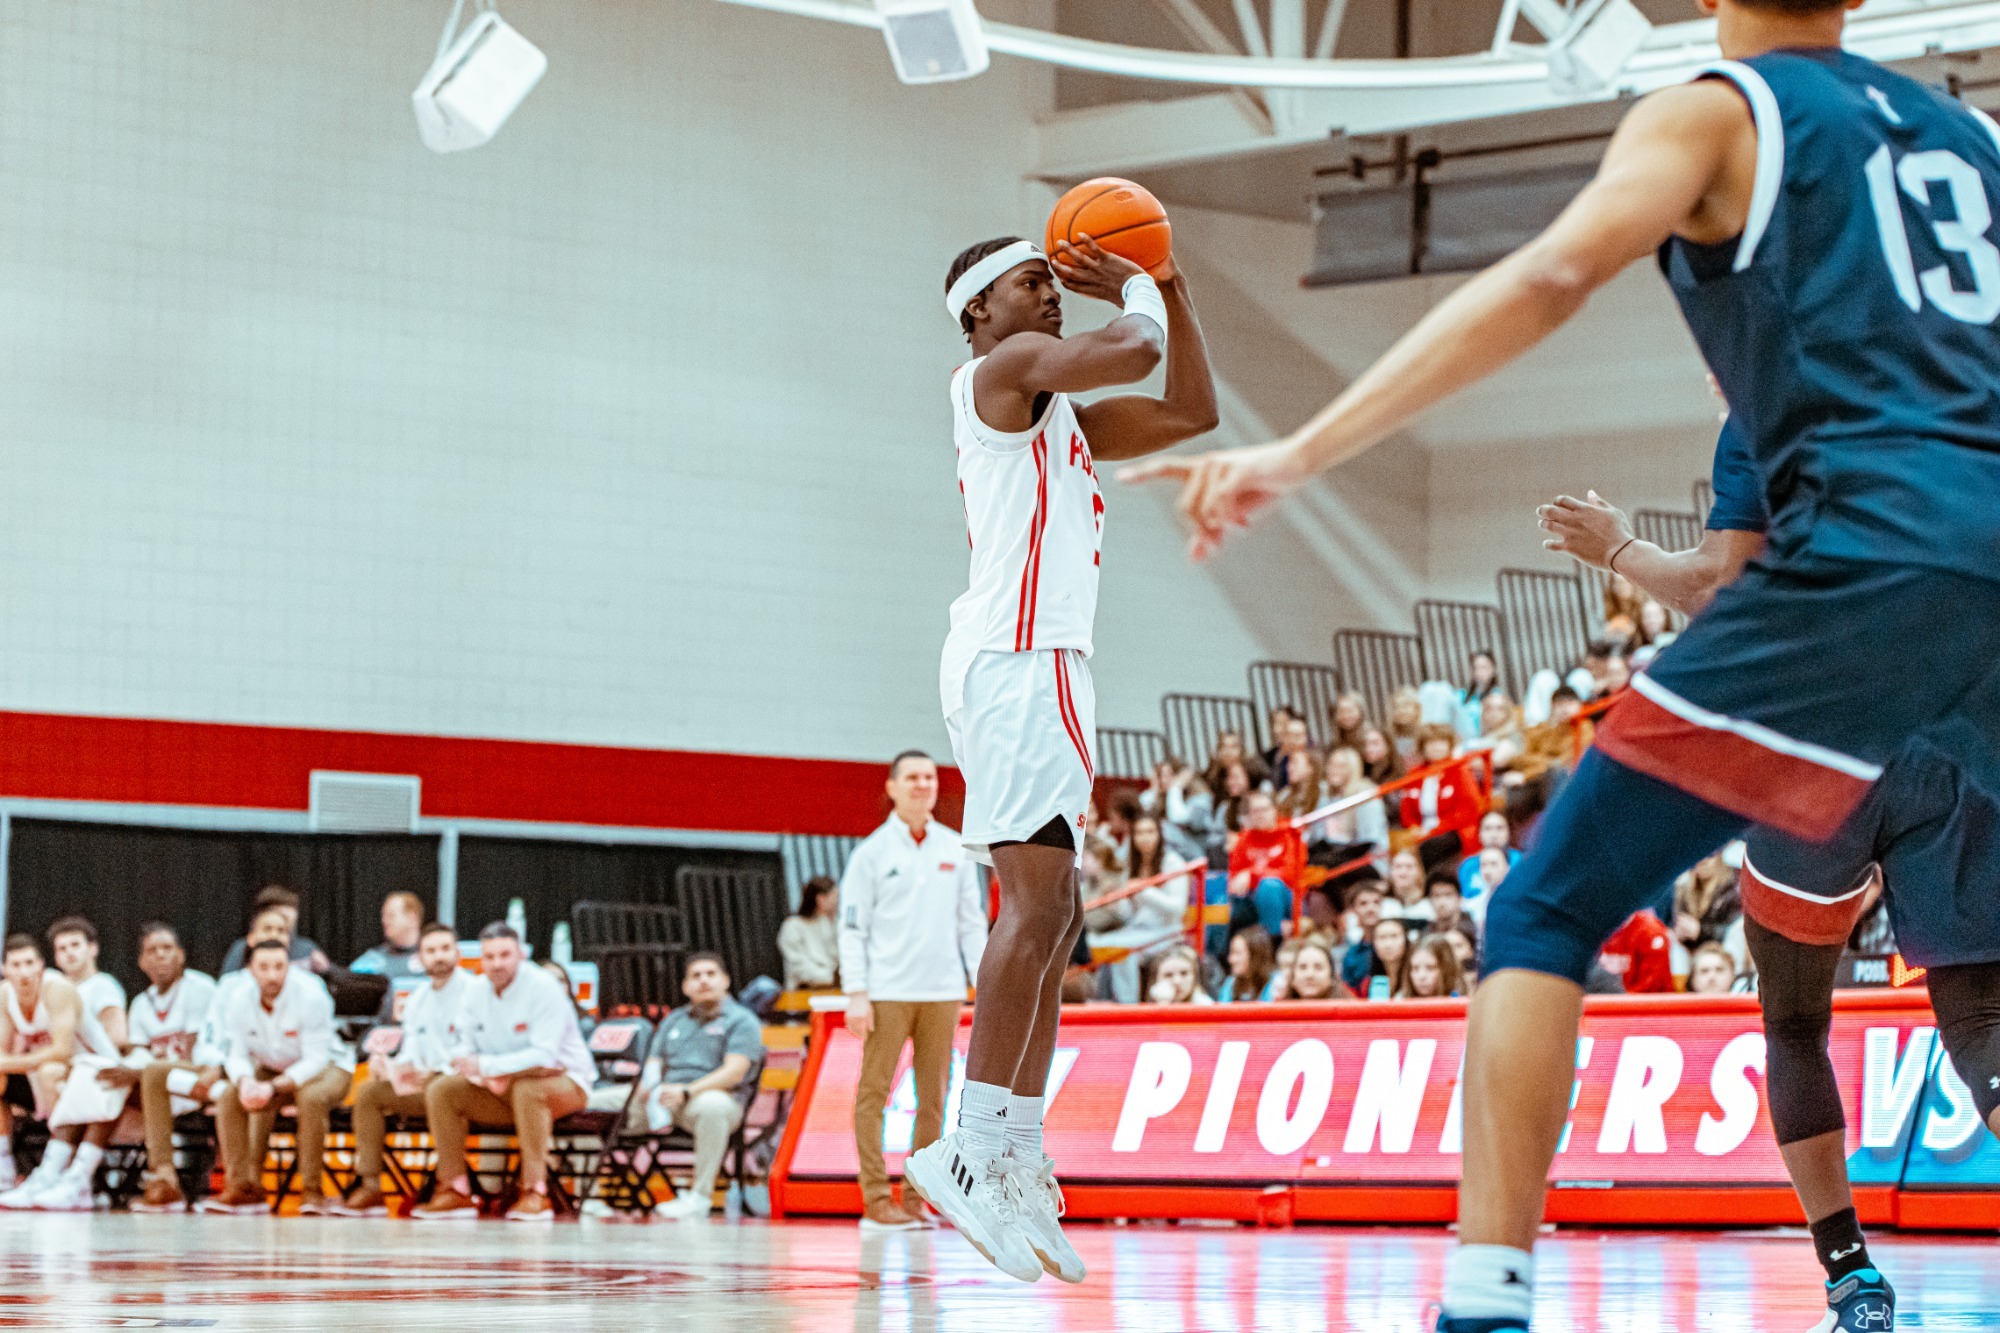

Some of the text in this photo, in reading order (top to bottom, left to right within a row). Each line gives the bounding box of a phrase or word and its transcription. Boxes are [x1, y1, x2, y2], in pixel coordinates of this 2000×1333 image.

[1864, 144, 2000, 324] 13
[1111, 1032, 1767, 1156] PIONRS
[1861, 1026, 1982, 1151] VS
